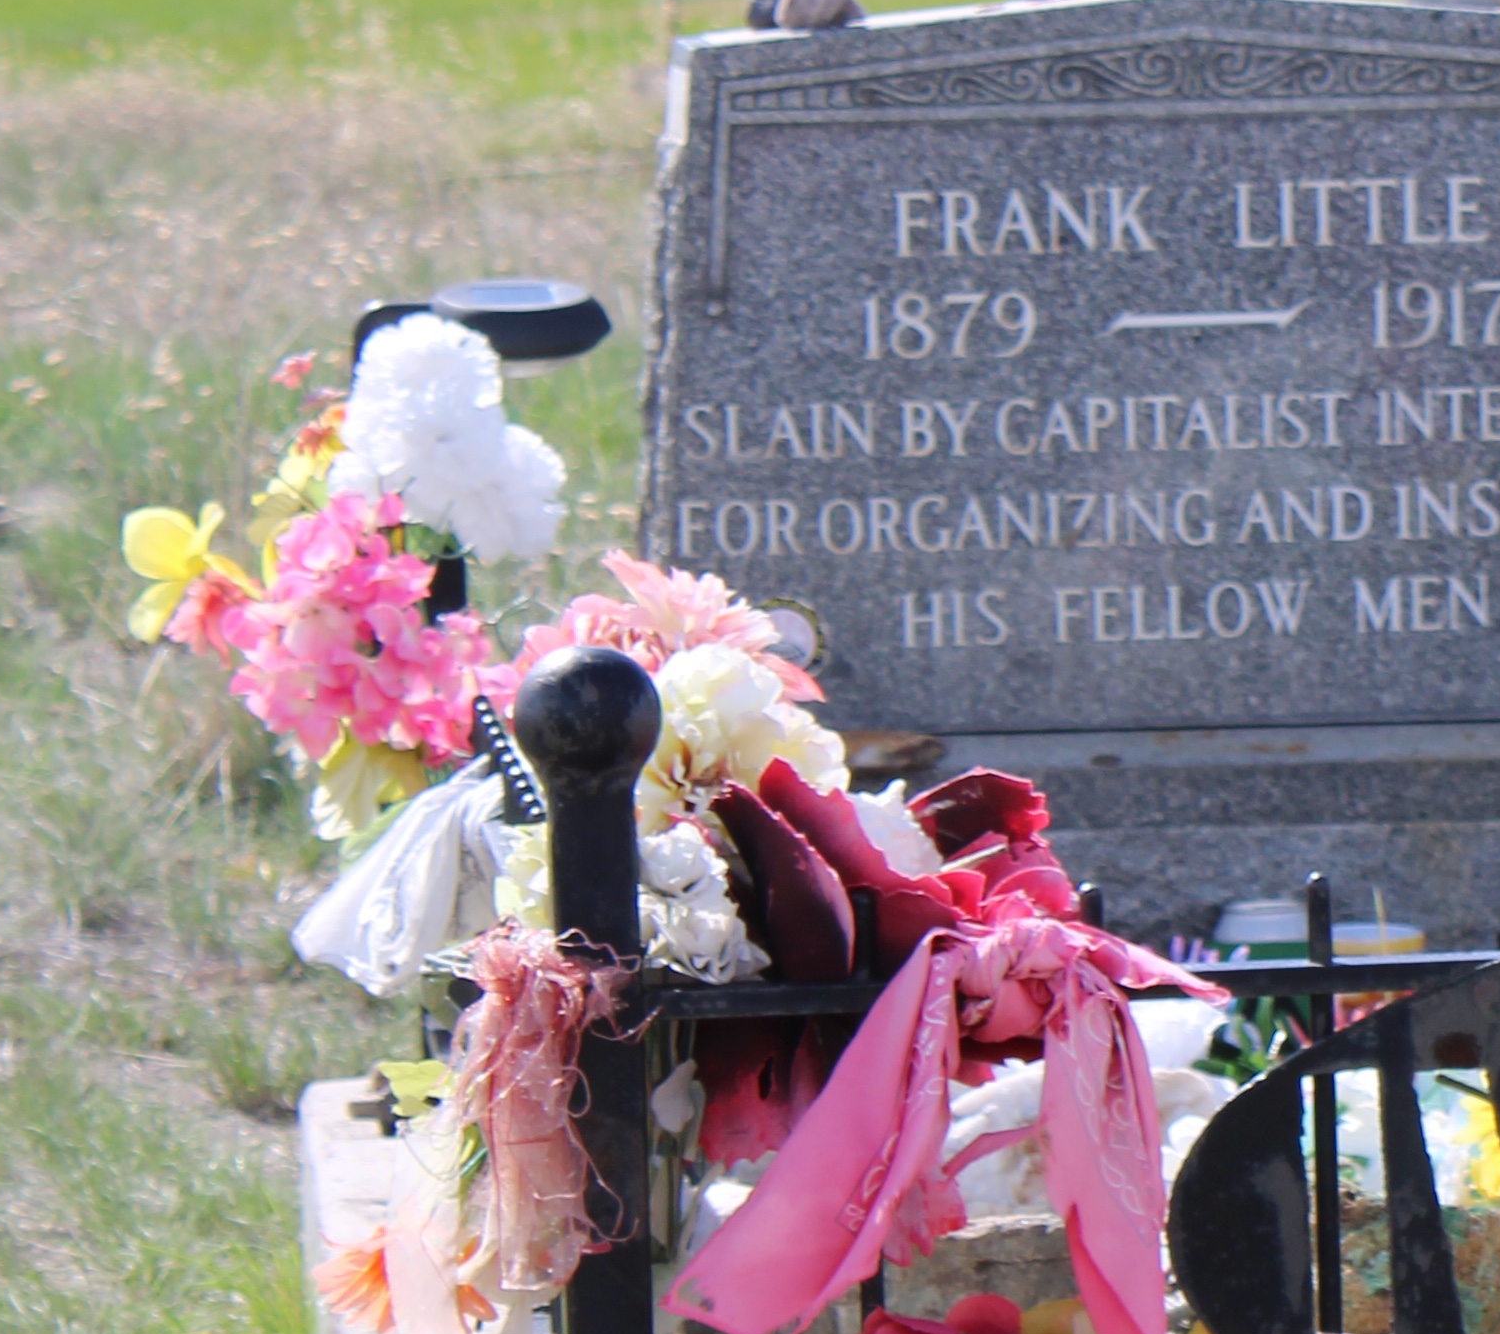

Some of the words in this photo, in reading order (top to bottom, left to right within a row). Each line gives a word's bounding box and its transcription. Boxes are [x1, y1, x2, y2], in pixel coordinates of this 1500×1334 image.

[893, 179, 1158, 258] FRANK
[1234, 174, 1492, 251] LITTLE
[860, 289, 1038, 361] 1879
[682, 398, 877, 463] SLAIN
[900, 398, 982, 458] BY
[994, 390, 1351, 456] CAPITALIST
[677, 498, 801, 558] FOR
[817, 488, 1217, 555] ORGANIZING
[1237, 485, 1375, 544] AND
[900, 588, 1011, 650] HIS
[1053, 577, 1313, 645] FELLOW
[1353, 573, 1492, 634] MEN
